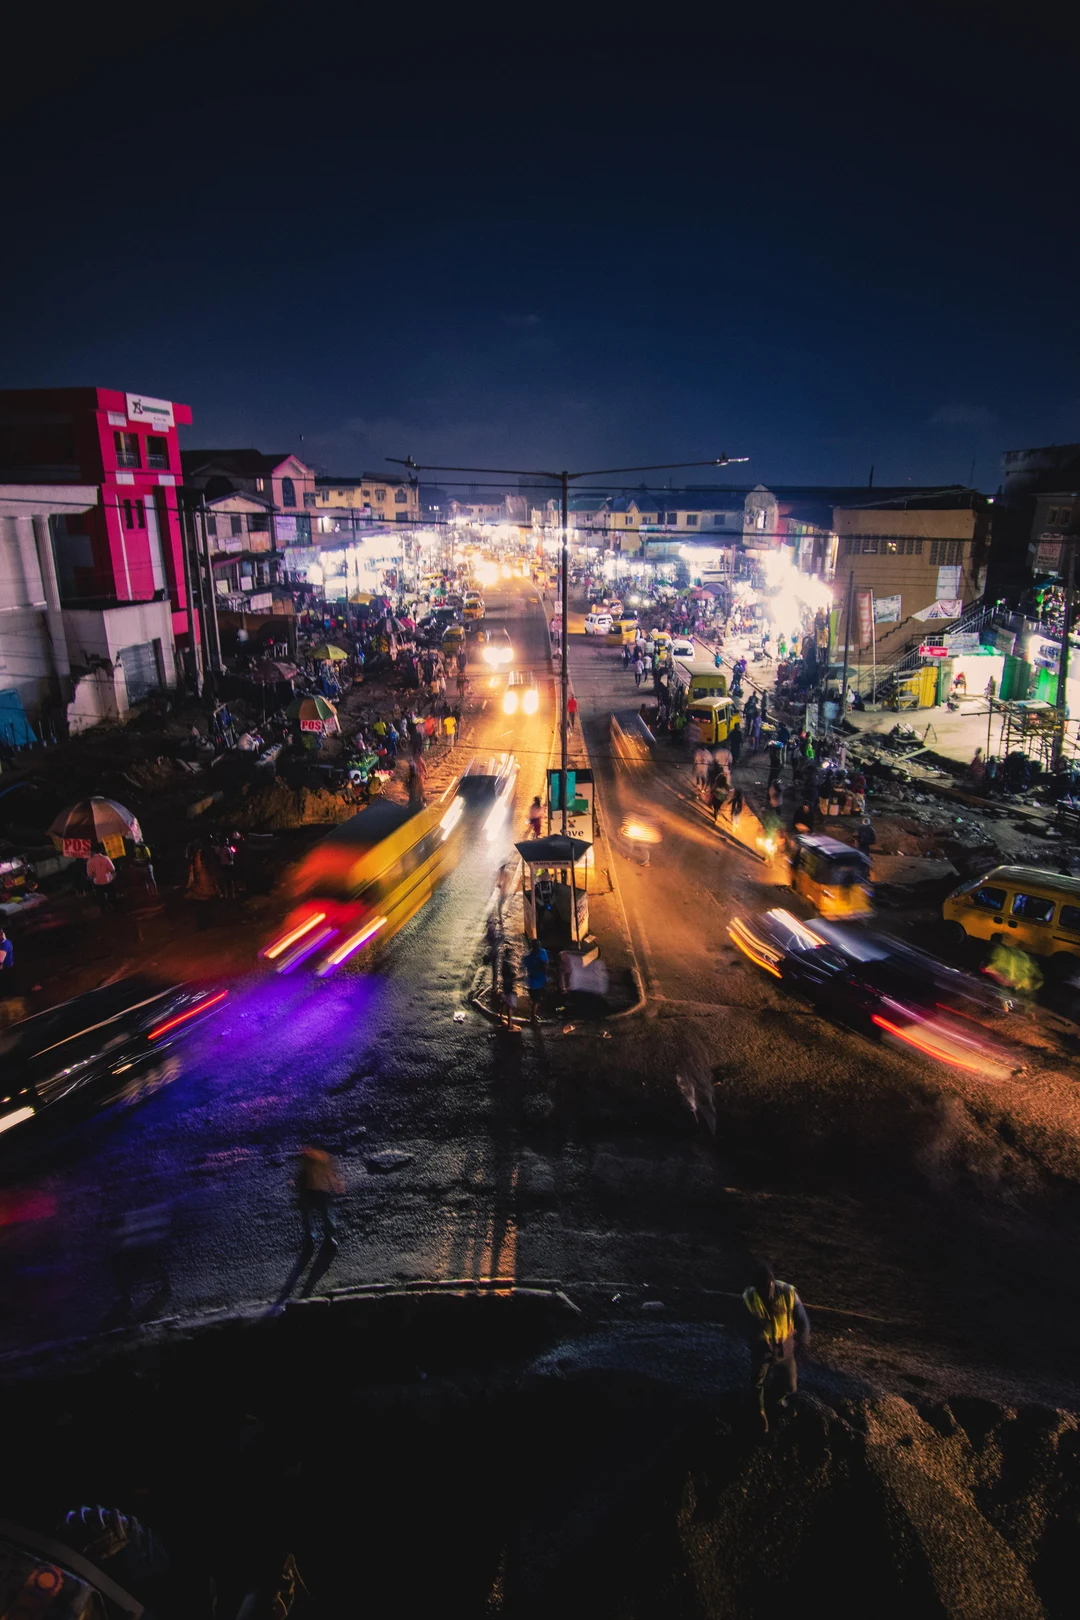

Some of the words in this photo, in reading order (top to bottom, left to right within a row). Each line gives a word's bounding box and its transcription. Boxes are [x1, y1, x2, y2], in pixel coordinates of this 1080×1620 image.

[302, 720, 321, 730] POS
[563, 829, 584, 837] ave
[64, 839, 91, 852] POS
